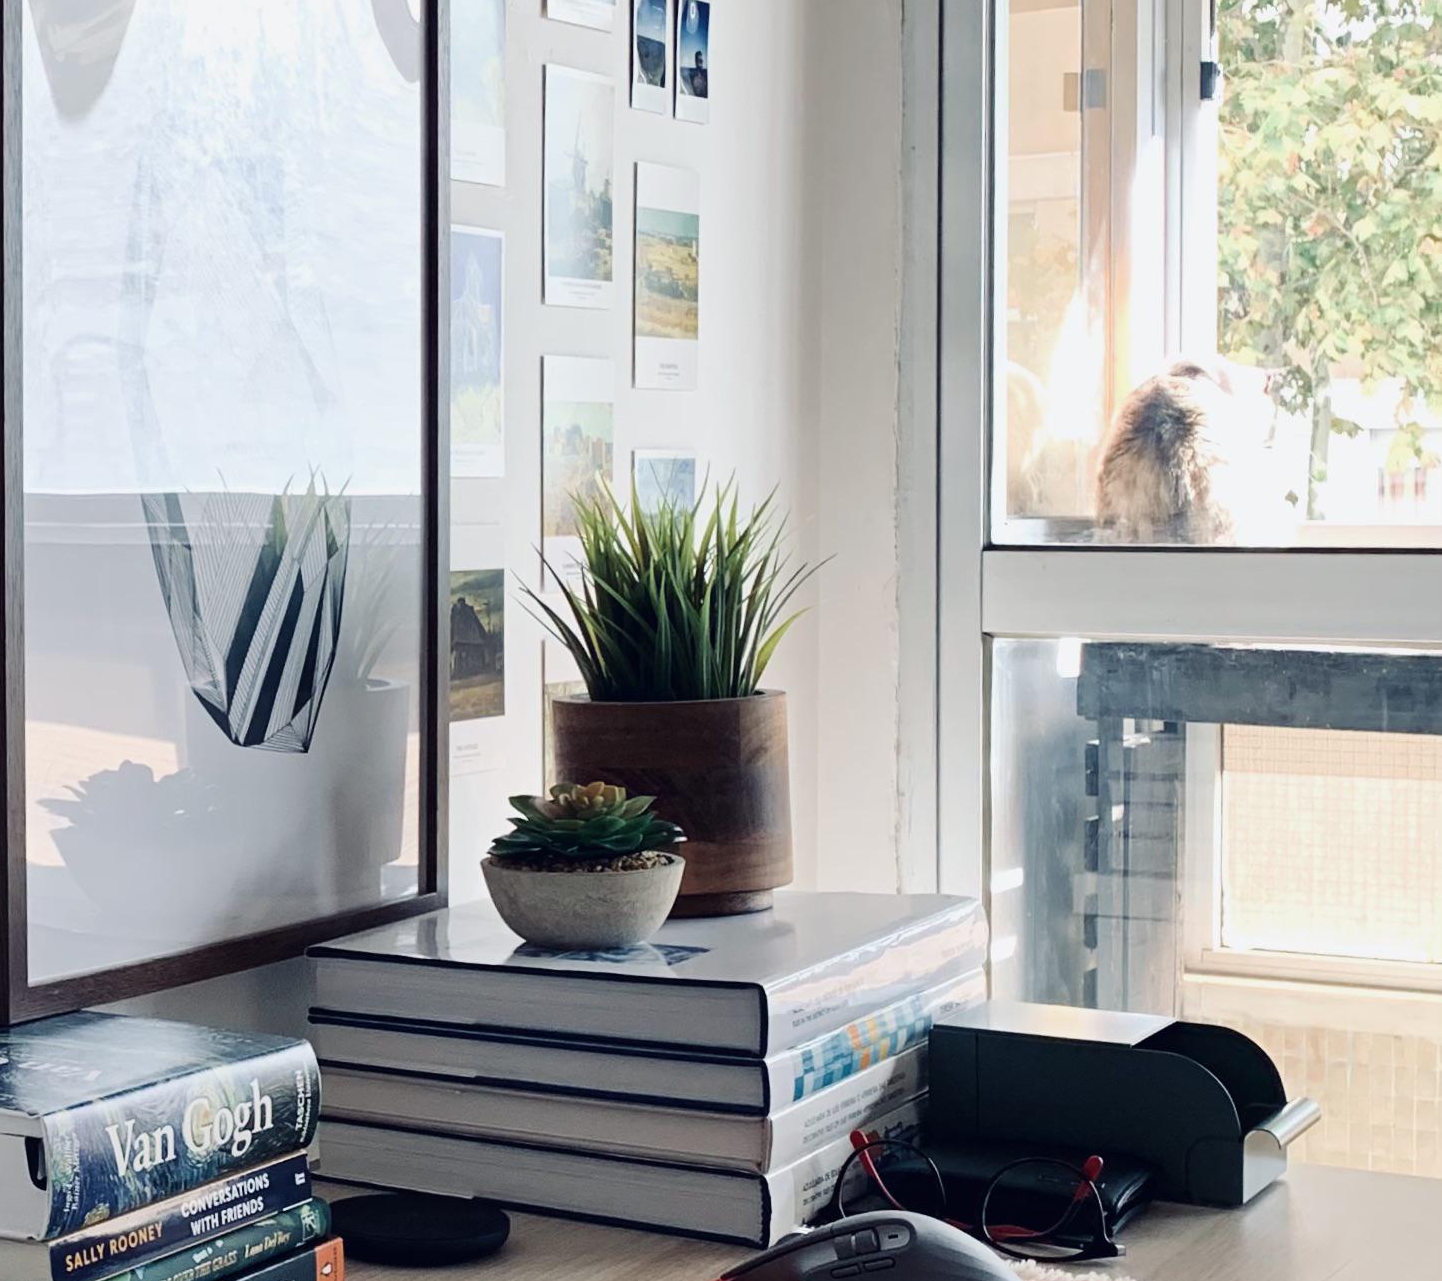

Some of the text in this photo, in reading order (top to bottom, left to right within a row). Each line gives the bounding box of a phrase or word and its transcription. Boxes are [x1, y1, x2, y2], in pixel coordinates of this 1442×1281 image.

[295, 1069, 306, 1131] TASCHEN
[104, 1118, 177, 1177] Van
[182, 1077, 275, 1158] Gogh
[180, 1172, 271, 1219] CONVERSATIONS
[190, 1197, 265, 1237] WITH FRIENDS
[64, 1221, 164, 1273] SALLY ROONEY
[194, 1261, 211, 1280] THE
[212, 1250, 239, 1272] GRASS
[243, 1241, 264, 1260] Lana
[263, 1231, 277, 1252] Del
